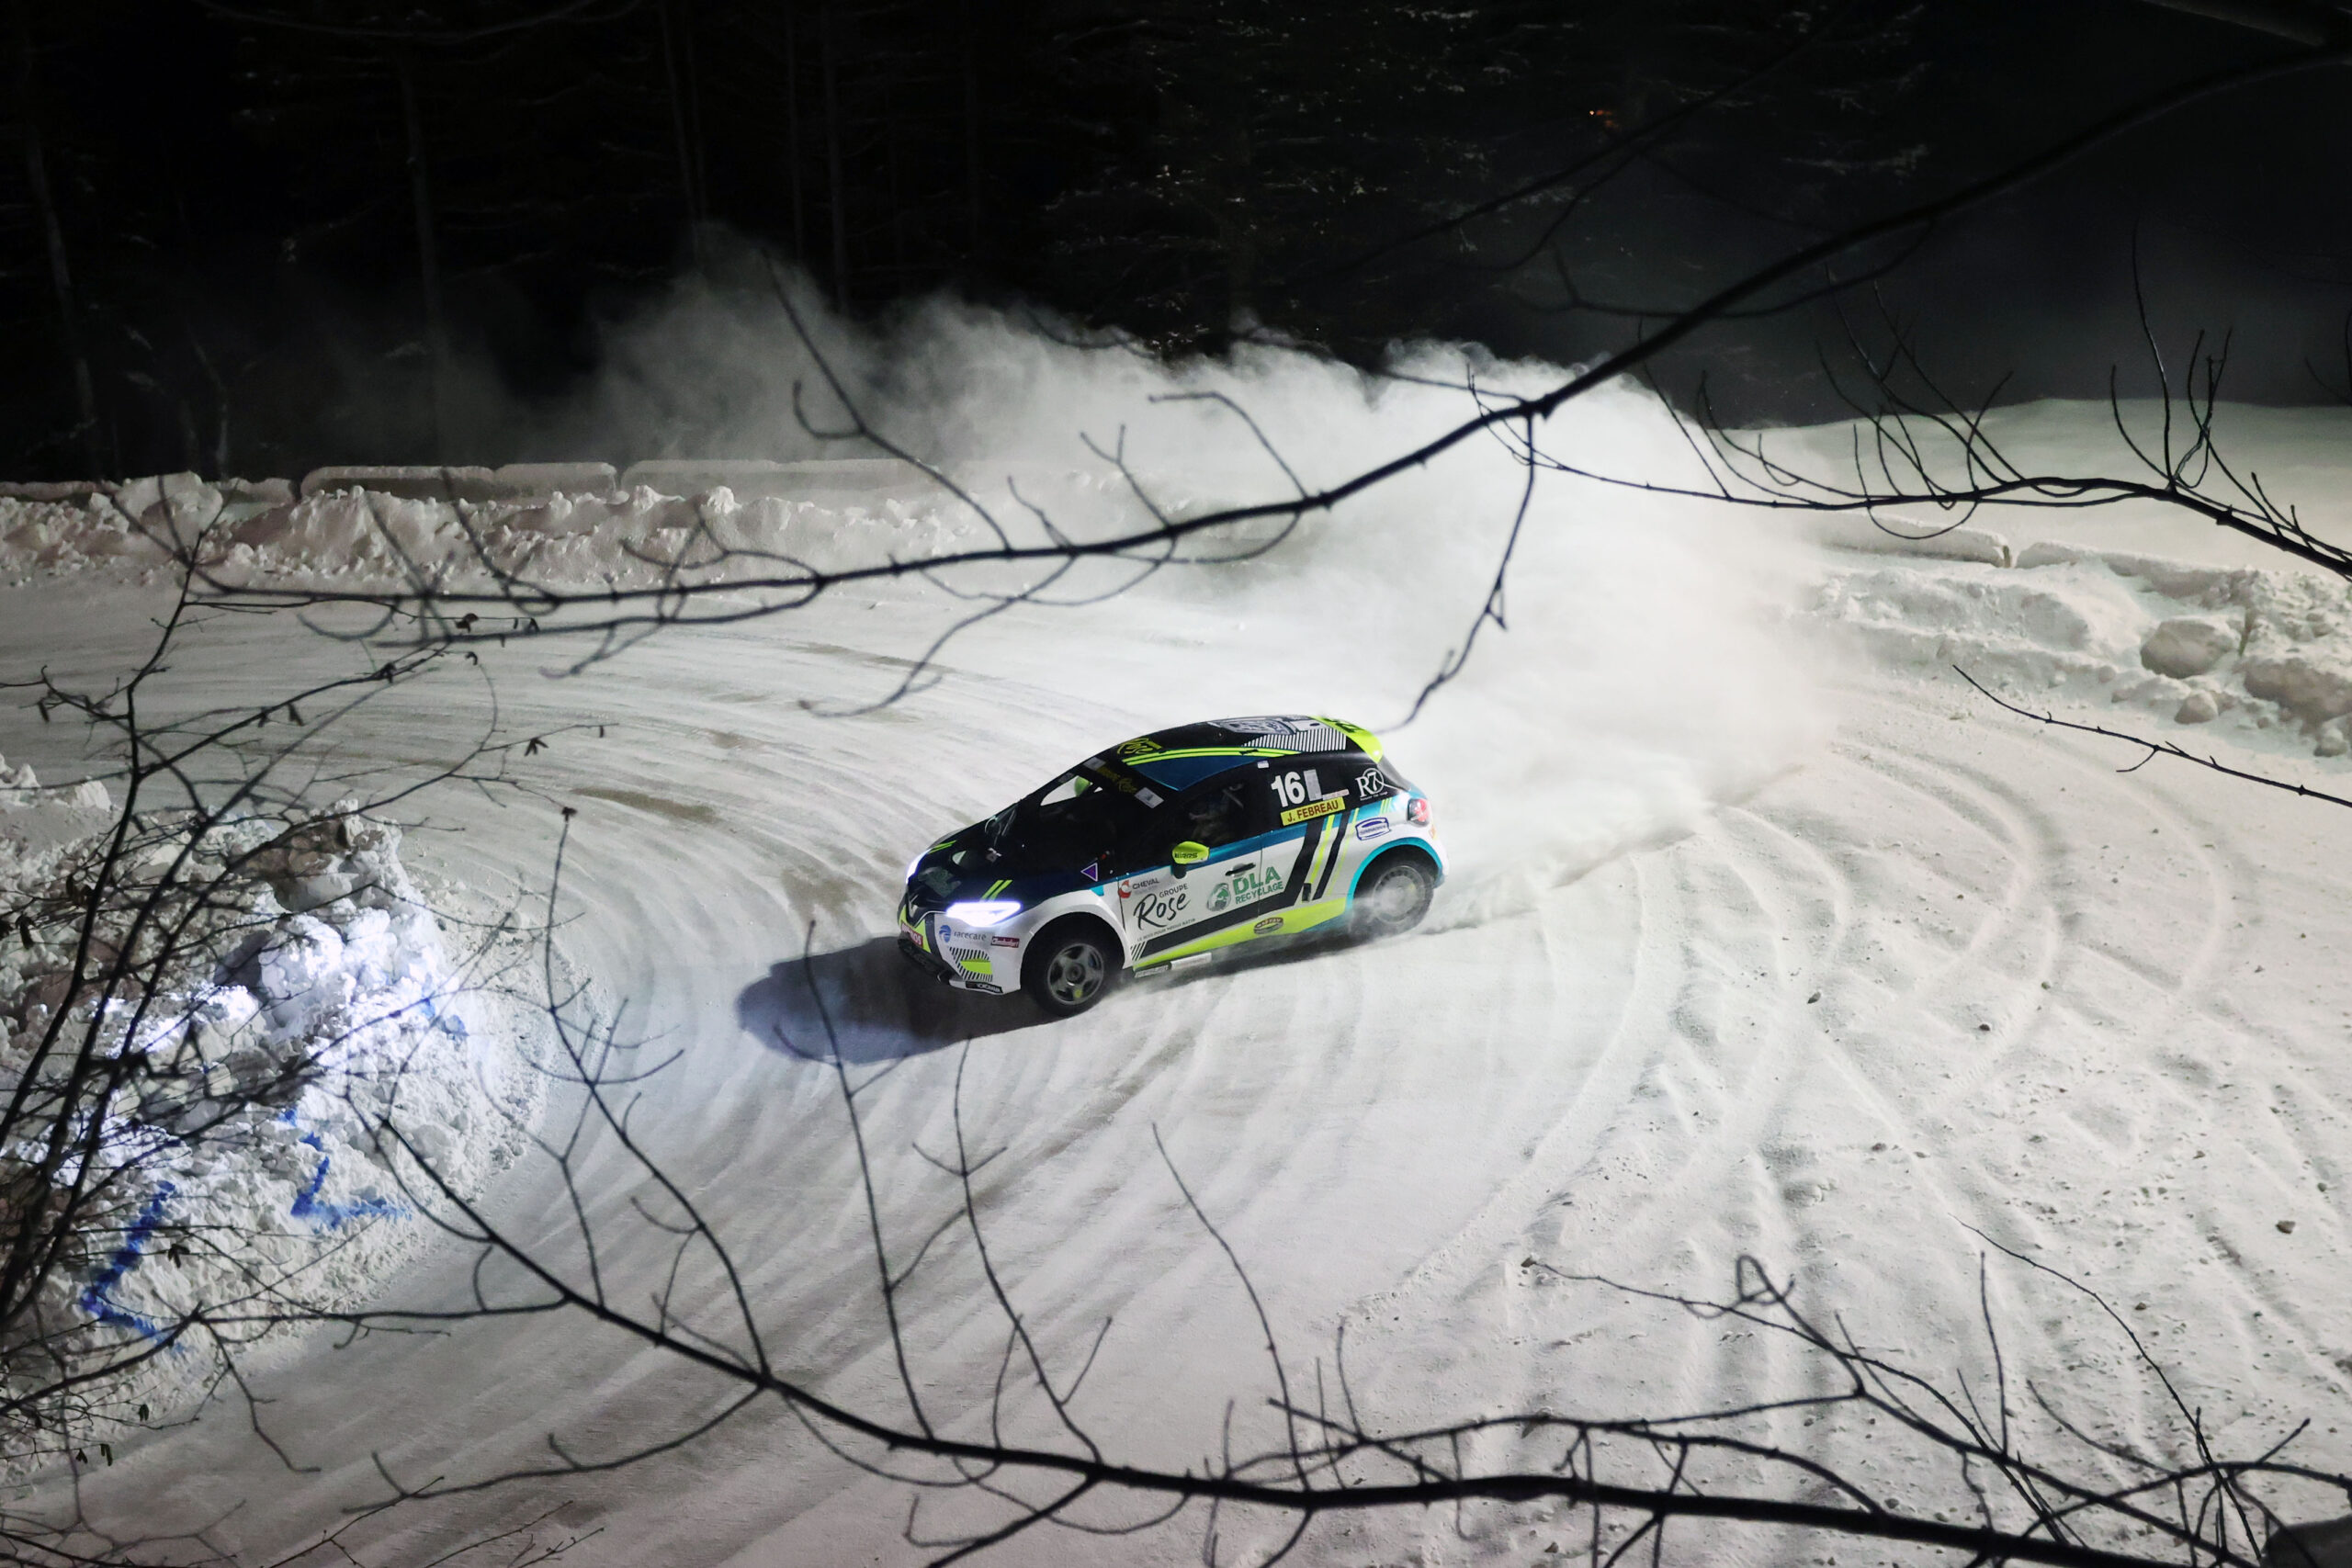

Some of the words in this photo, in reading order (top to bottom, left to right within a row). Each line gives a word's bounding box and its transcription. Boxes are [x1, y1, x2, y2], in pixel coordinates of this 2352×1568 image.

[1355, 769, 1383, 797] R7
[1287, 814, 1295, 822] J.
[1296, 800, 1339, 818] FEBREAU
[1132, 878, 1159, 889] CHEVAL
[1159, 884, 1189, 898] GROUPE
[1233, 866, 1281, 895] DLA
[1236, 881, 1283, 904] RECYCLAGE
[1133, 893, 1191, 931] Rose
[954, 930, 987, 942] racecare
